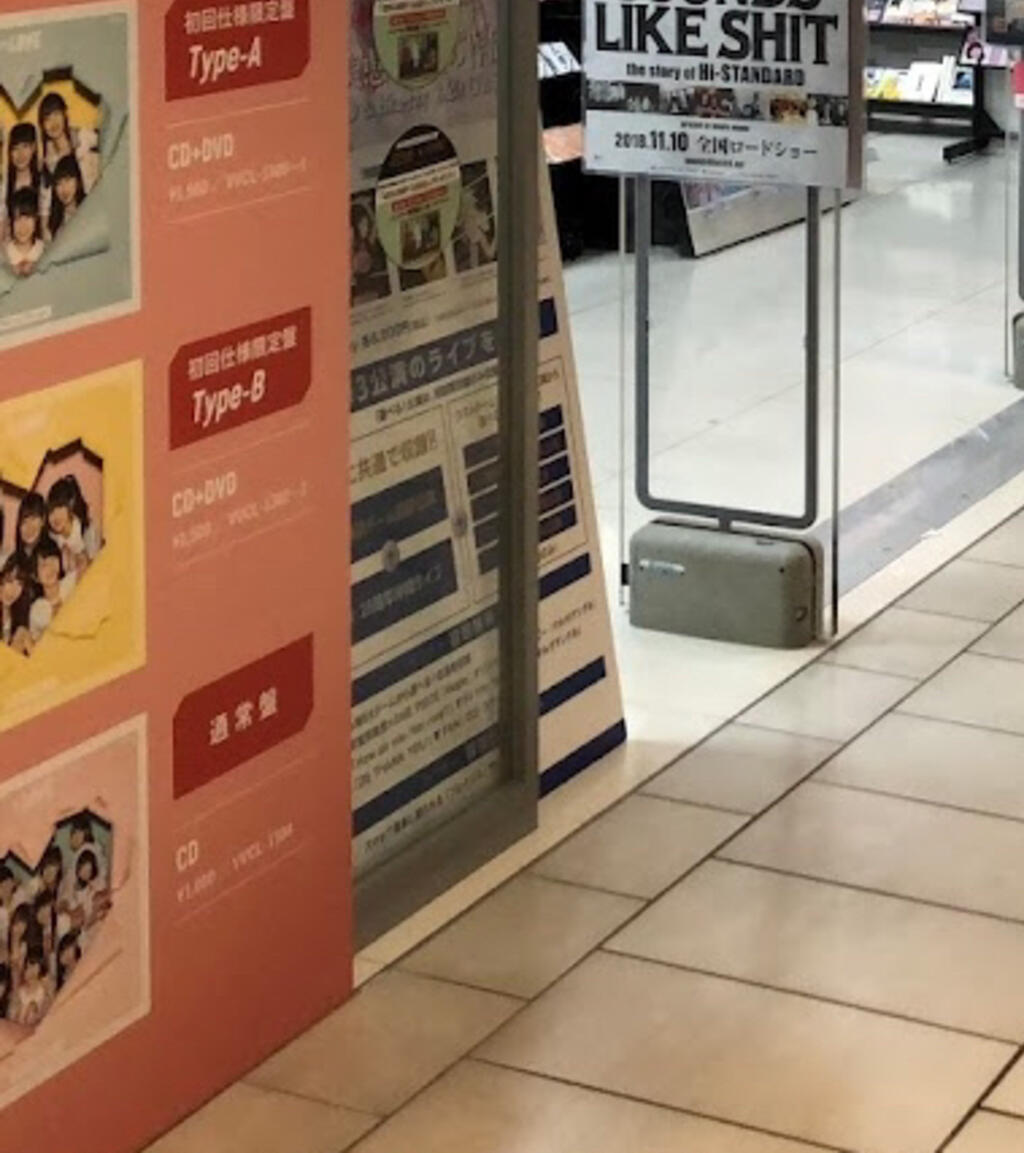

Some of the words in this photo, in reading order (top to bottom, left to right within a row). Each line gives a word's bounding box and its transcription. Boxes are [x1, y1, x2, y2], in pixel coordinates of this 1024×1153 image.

[594, 2, 708, 58] LIKE
[717, 9, 838, 65] SHIT
[188, 36, 262, 85] Type-A
[626, 62, 647, 76] the
[649, 65, 681, 81] story
[684, 66, 696, 80] of
[698, 63, 805, 86] Hi-STANDARD
[167, 133, 235, 170] CD+DVD
[192, 369, 266, 428] Type-B
[172, 471, 238, 518] CD+DVD
[175, 840, 199, 871] CD
